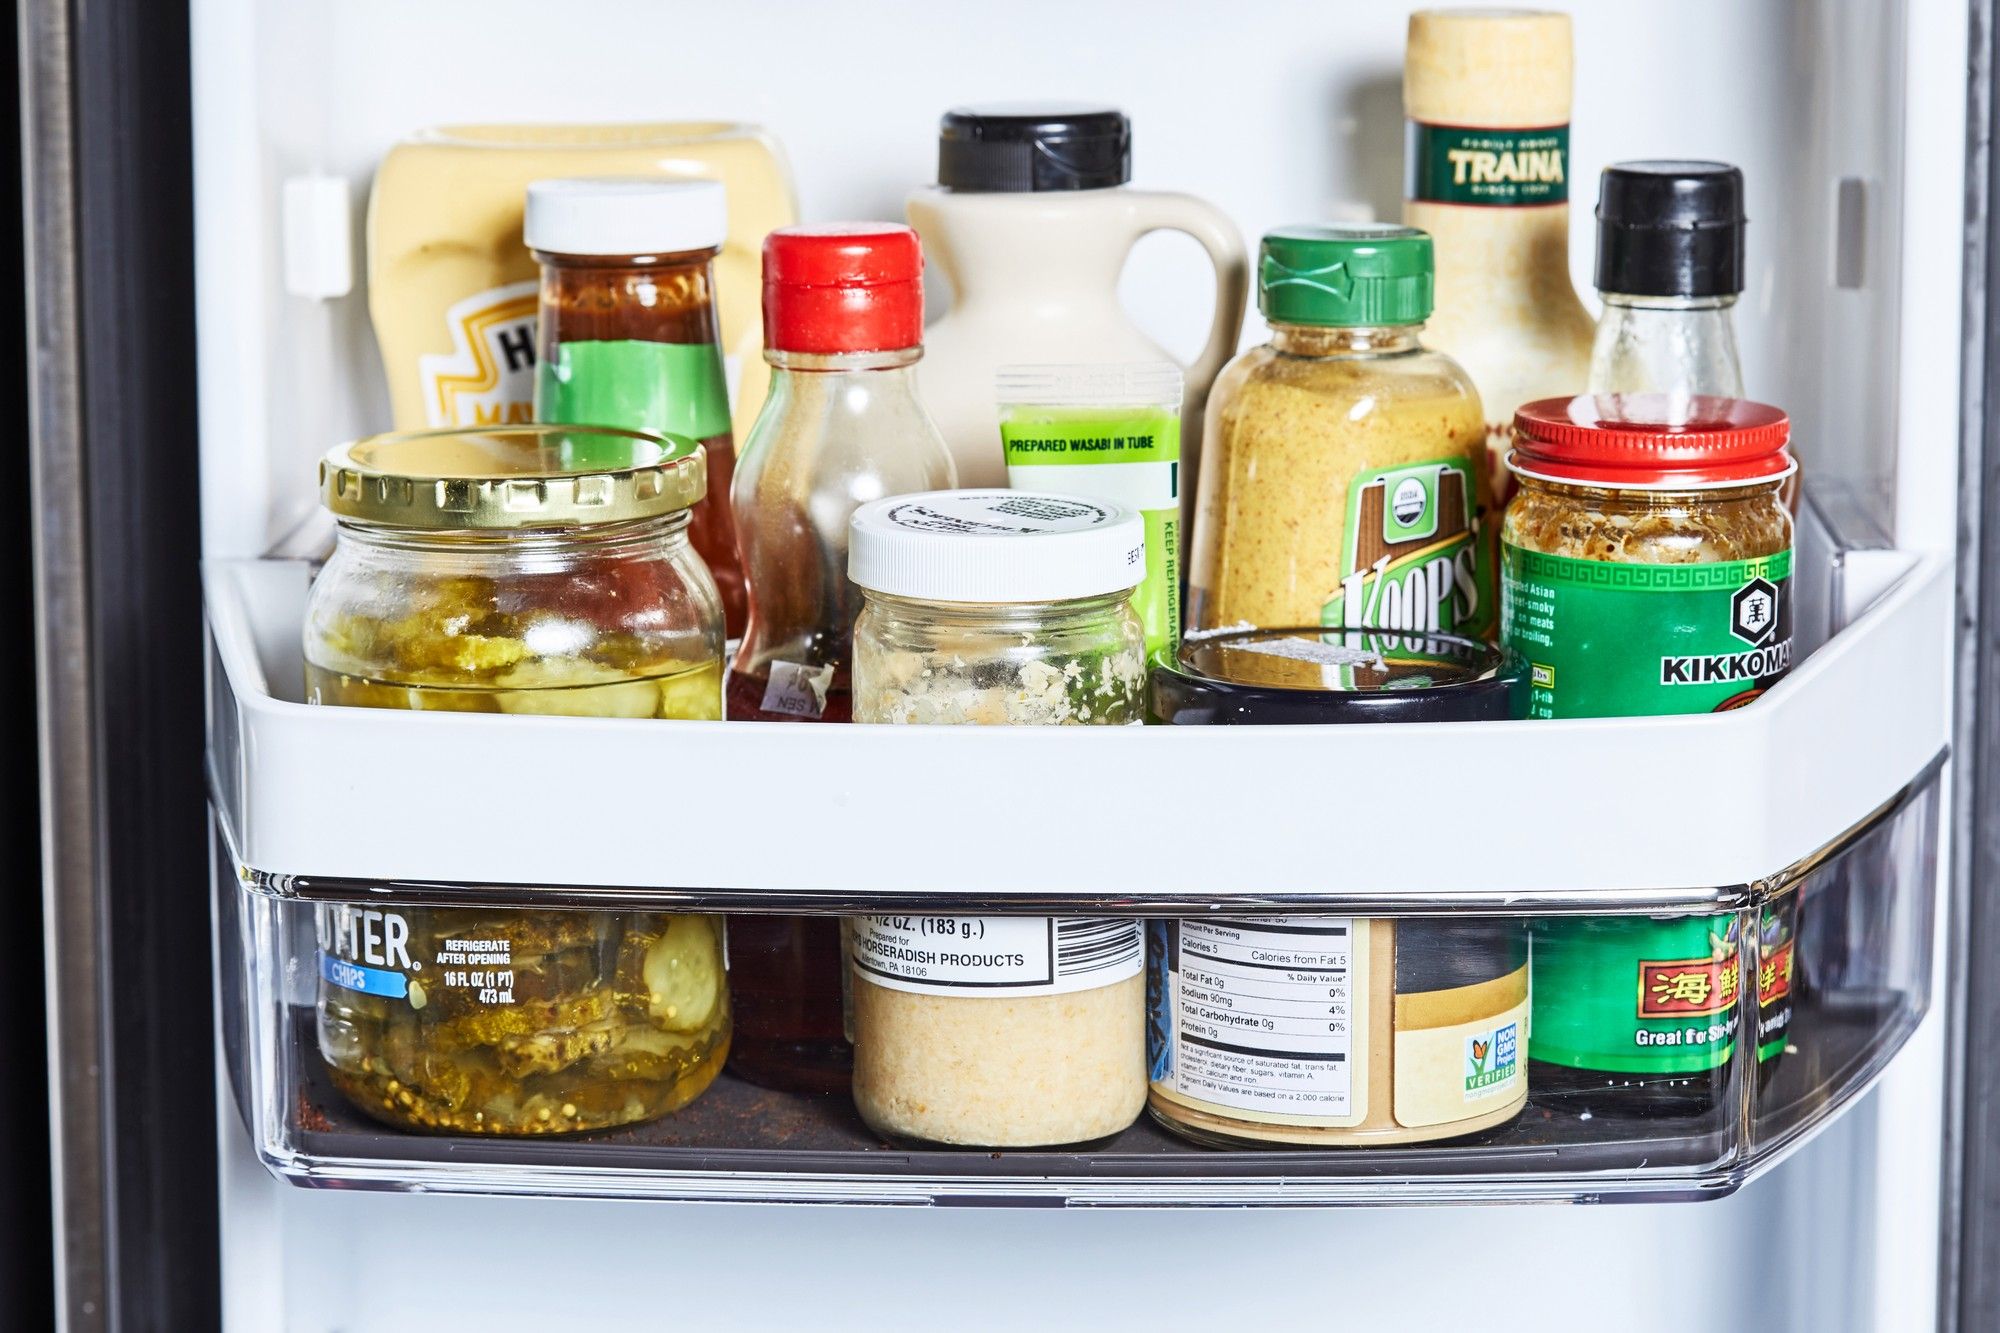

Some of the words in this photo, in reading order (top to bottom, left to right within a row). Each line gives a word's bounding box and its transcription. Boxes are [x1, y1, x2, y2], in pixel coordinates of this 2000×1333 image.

[1448, 150, 1565, 185] TRAINA
[498, 324, 536, 373] H
[1010, 439, 1067, 452] PREPARED
[1070, 438, 1111, 451] WASABI
[1114, 437, 1125, 449] IN
[1127, 435, 1154, 449] TUBE
[1164, 521, 1174, 555] KEEP
[1530, 583, 1555, 599] Asian
[1529, 615, 1554, 630] meats
[1661, 639, 1793, 685] KIKKOMA
[921, 917, 956, 937] (183
[1182, 922, 1203, 933] Amount
[1203, 925, 1214, 935] Per
[1214, 928, 1240, 940] Serving
[445, 939, 511, 952] REFRIGERATE
[869, 928, 897, 944] Prepared
[899, 935, 910, 946] for
[1182, 937, 1211, 952] Calories
[1212, 944, 1218, 954] 5
[436, 952, 466, 964] AFTER
[467, 953, 511, 965] OPENING
[862, 936, 936, 964] HORSERADISH
[940, 953, 1025, 967] PRODUCTS
[1251, 950, 1291, 963] Calories
[1294, 954, 1317, 965] from
[1320, 955, 1337, 965] Fat
[1340, 955, 1347, 965] 5
[332, 963, 366, 989] CHIPS
[889, 962, 899, 973] PA
[901, 965, 928, 977] 18106
[444, 971, 456, 987] 16
[457, 971, 470, 987] FL
[471, 971, 485, 987] OZ
[497, 970, 514, 988] PT)
[1181, 968, 1199, 981] Total
[1200, 973, 1213, 985] Fat
[1214, 976, 1225, 989] 0g
[1296, 974, 1317, 983] Daily
[479, 988, 498, 1004] 473
[1181, 985, 1208, 1001] Sodium
[1210, 992, 1233, 1008] 90mg
[1329, 988, 1346, 998] 0%
[1181, 1001, 1199, 1015] Total
[1199, 1007, 1259, 1027] Carbohydrate
[1261, 1018, 1274, 1031] 0g
[1328, 1005, 1346, 1015] 4%
[1181, 1019, 1206, 1035] Protein
[1208, 1026, 1218, 1038] 0g
[1328, 1022, 1346, 1032] 0%
[1497, 1026, 1516, 1045] NON
[1635, 1029, 1682, 1046] Great
[1497, 1038, 1516, 1057] GMO
[1223, 1054, 1246, 1064] source
[1255, 1059, 1289, 1069] saturated
[1497, 1051, 1516, 1067] Project
[1206, 1069, 1229, 1079] calcium
[1229, 1074, 1242, 1082] and
[1279, 1070, 1305, 1079] vitamin
[1468, 1063, 1516, 1089] VERIFIED
[1202, 1080, 1217, 1090] Daily
[1218, 1084, 1240, 1094] Values
[1241, 1088, 1252, 1096] are
[1253, 1089, 1276, 1099] based
[1319, 1094, 1345, 1102] calorie
